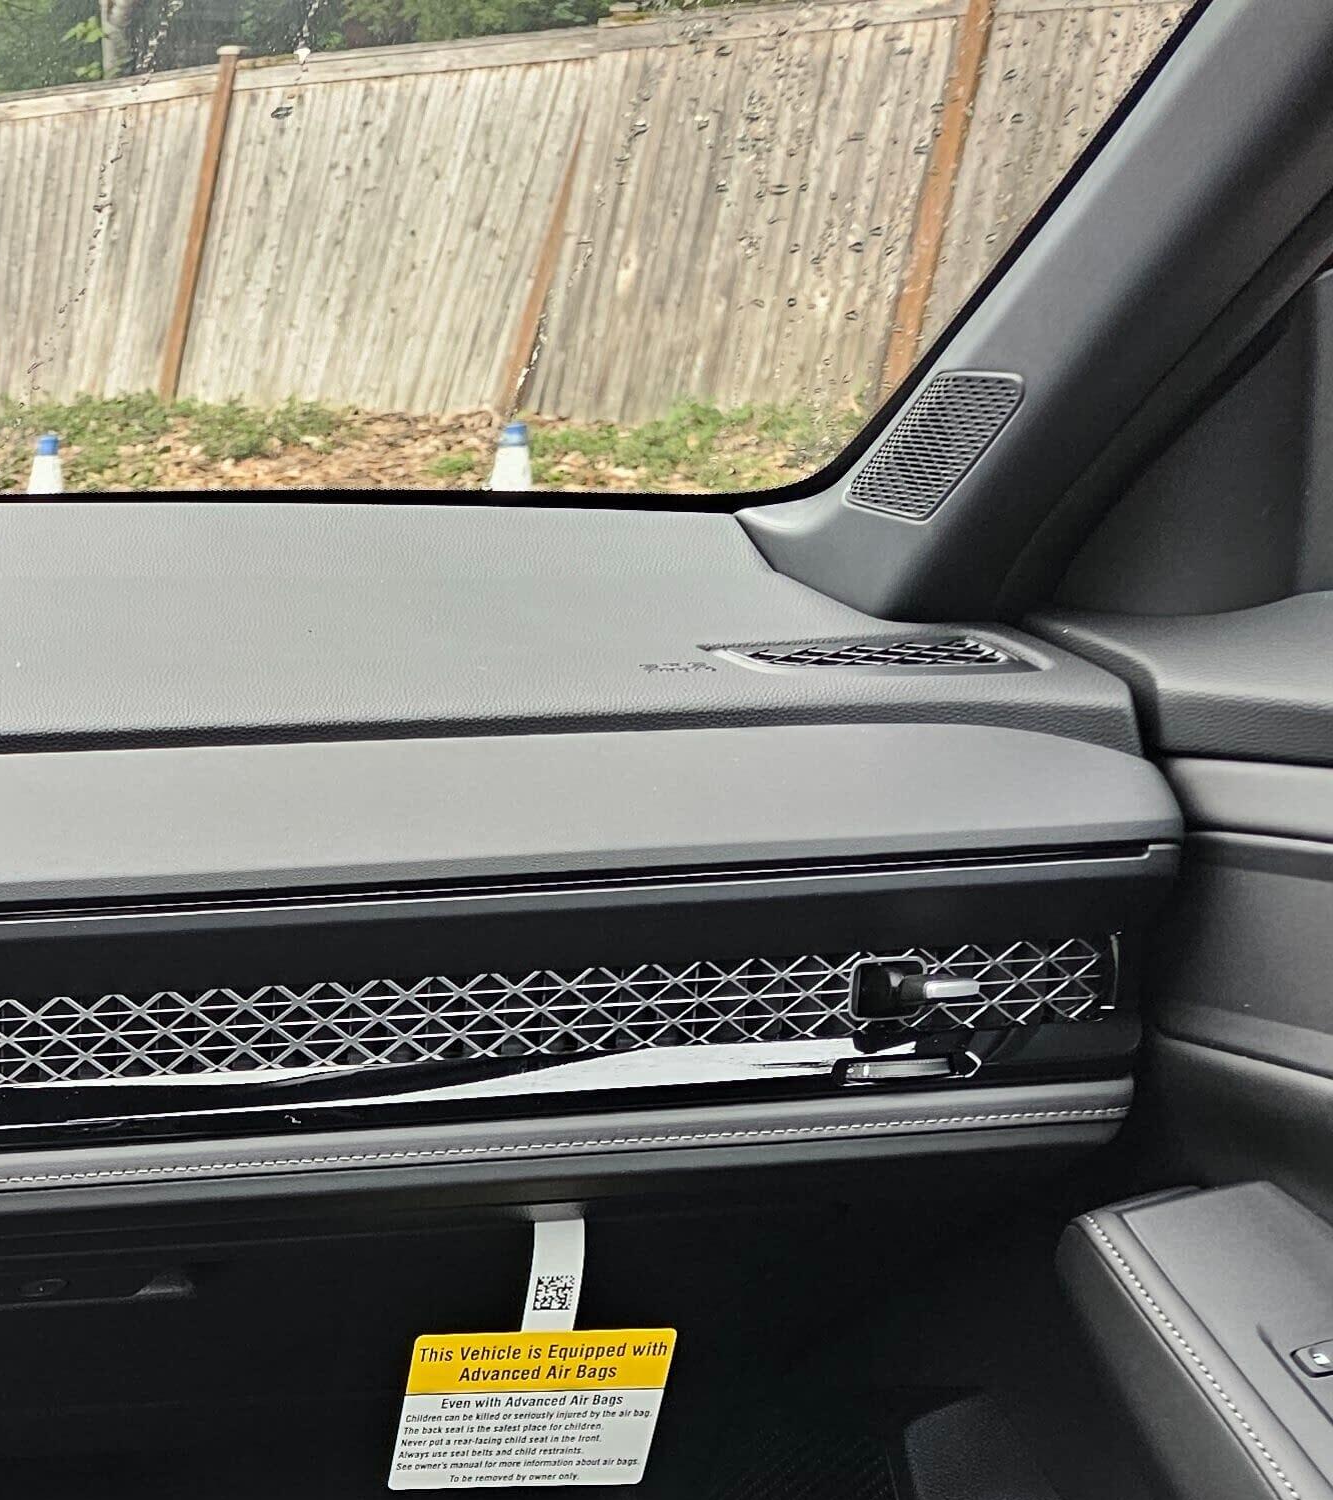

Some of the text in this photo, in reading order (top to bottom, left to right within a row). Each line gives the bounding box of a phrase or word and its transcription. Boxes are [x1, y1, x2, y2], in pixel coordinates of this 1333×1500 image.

[419, 1341, 668, 1362] This Vehicle is Equipped with
[459, 1364, 618, 1382] Advanced Air Bags
[441, 1394, 624, 1409] Even with Advanced Air Bags
[406, 1414, 442, 1423] Children
[462, 1413, 473, 1421] be
[475, 1412, 500, 1421] killed
[514, 1411, 553, 1422] seriously
[556, 1410, 588, 1420] injured
[589, 1410, 600, 1419] by
[602, 1410, 616, 1418] the
[633, 1409, 653, 1419] bag.
[404, 1427, 420, 1435] The
[422, 1426, 442, 1434] back
[477, 1425, 491, 1433] the
[493, 1424, 521, 1432] safest
[523, 1424, 547, 1433] place
[549, 1423, 562, 1431] for
[401, 1439, 427, 1447] Never
[429, 1438, 445, 1447] put
[453, 1437, 502, 1446] rear-facing
[504, 1436, 526, 1444] child
[398, 1451, 430, 1460] Always
[471, 1449, 493, 1457] belts
[514, 1448, 536, 1456] child
[396, 1463, 412, 1471] See
[415, 1462, 448, 1470] owner's
[450, 1461, 482, 1469] manual
[523, 1459, 573, 1467] information
[575, 1458, 600, 1466] about
[617, 1458, 640, 1467] bags.
[450, 1475, 460, 1483] To
[462, 1474, 472, 1482] be
[475, 1473, 513, 1482] removed
[515, 1473, 526, 1482] by
[559, 1472, 580, 1481] only.
